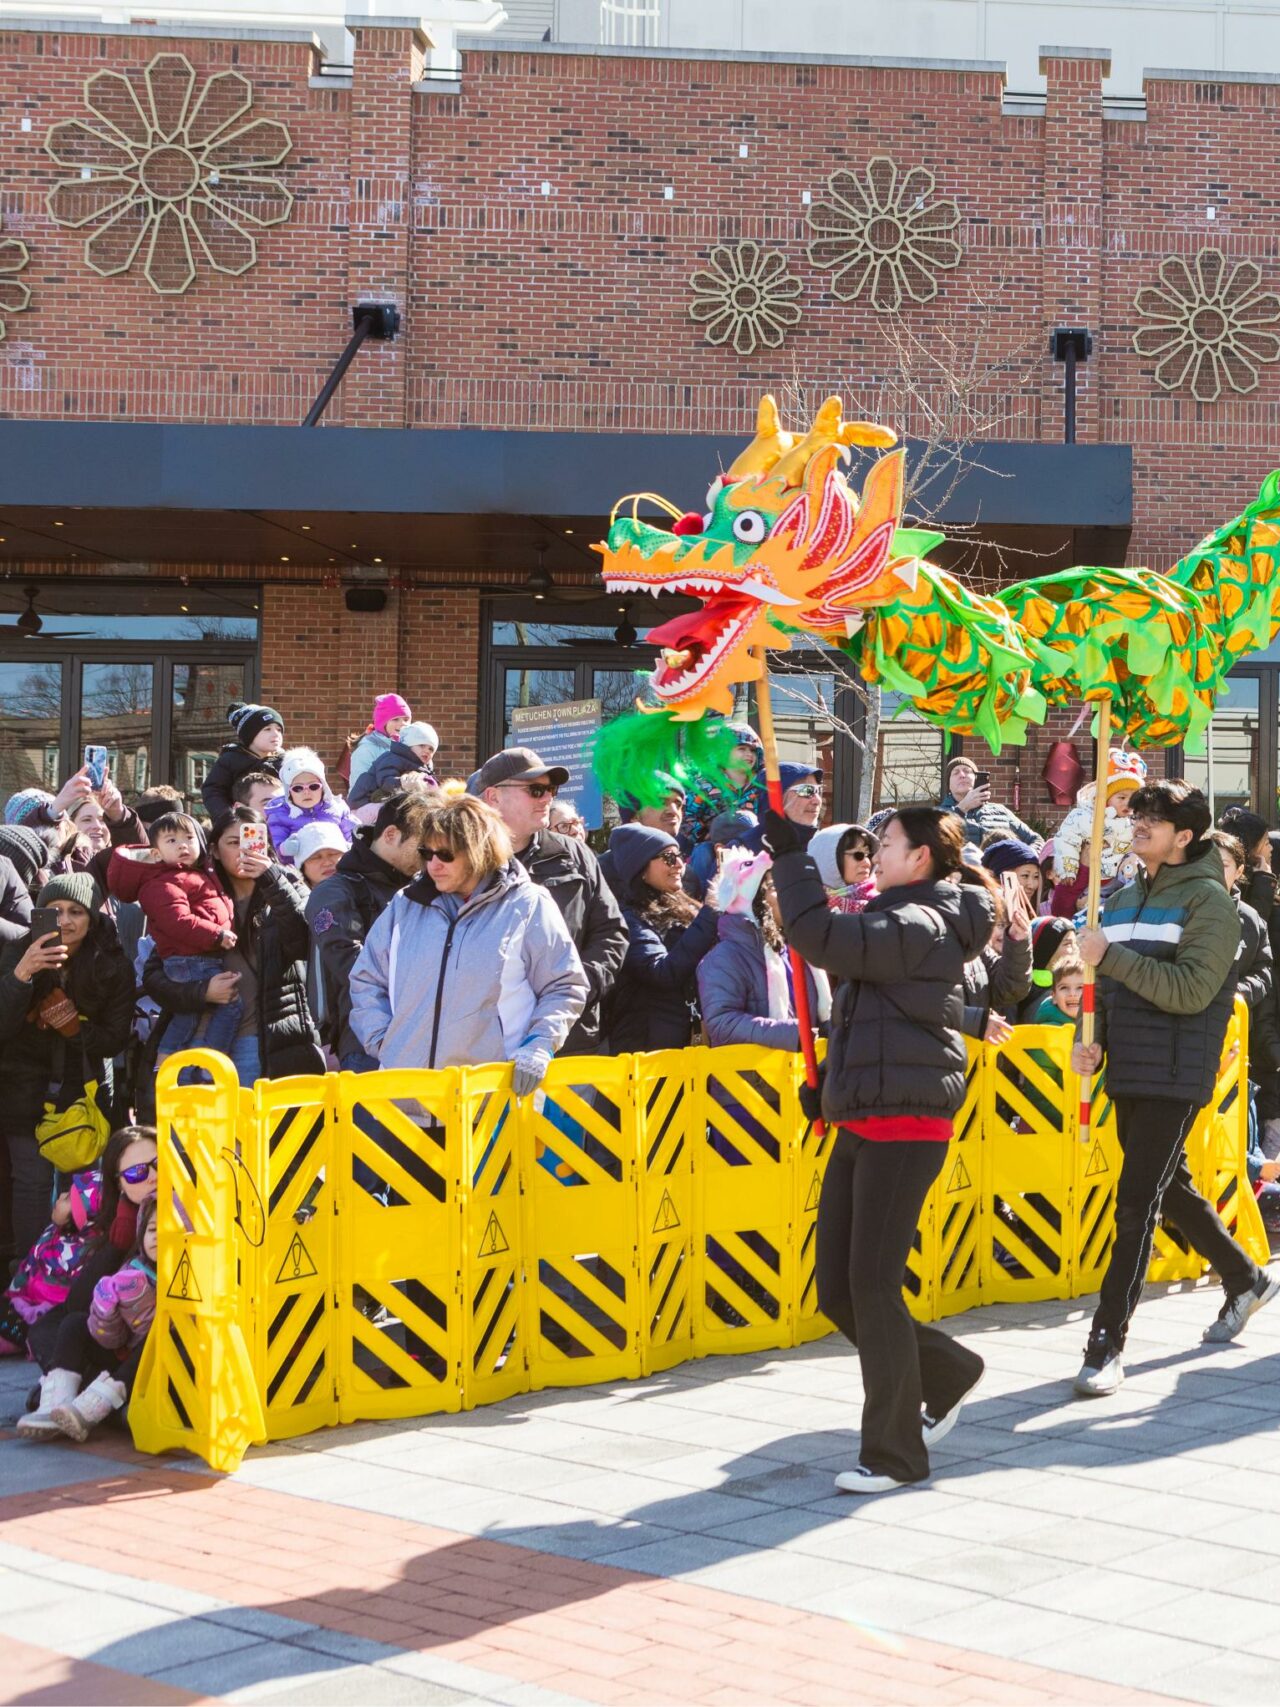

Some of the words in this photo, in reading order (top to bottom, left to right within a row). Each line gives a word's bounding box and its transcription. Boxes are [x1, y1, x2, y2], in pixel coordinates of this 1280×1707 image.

[515, 710, 552, 722] METUCHEN
[553, 706, 571, 718] TOWN
[573, 704, 597, 716] PLAZA
